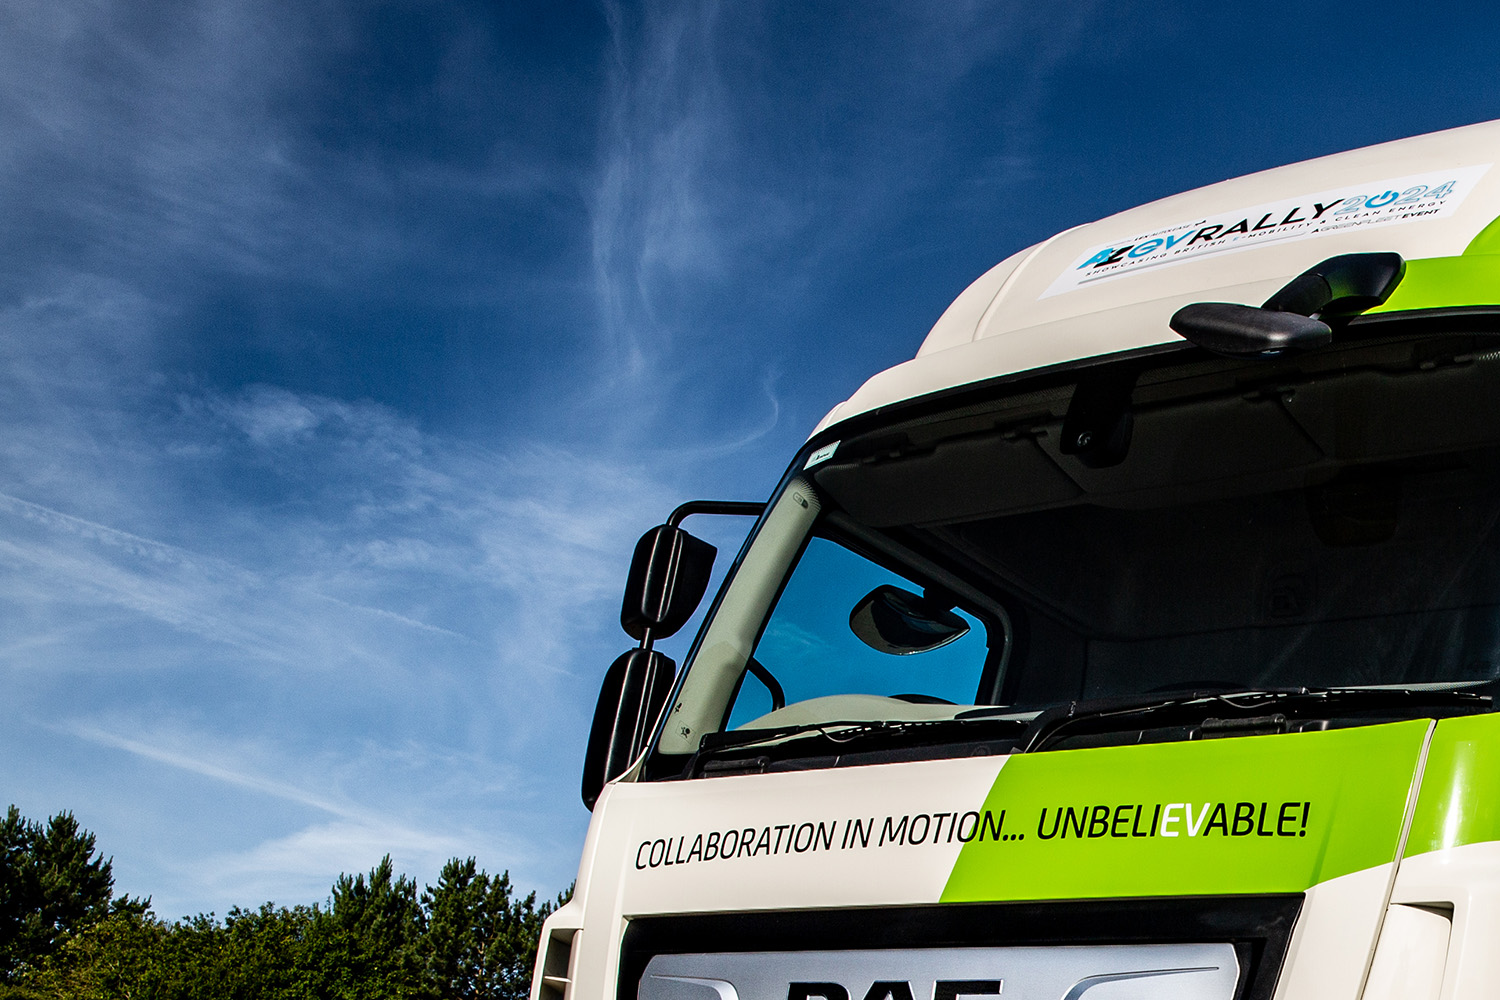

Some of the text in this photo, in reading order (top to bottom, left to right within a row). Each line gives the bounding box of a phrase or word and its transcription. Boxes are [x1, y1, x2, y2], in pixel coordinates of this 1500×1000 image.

[1085, 252, 1168, 276] SHOWCASING
[1174, 239, 1226, 255] BRITISH
[1232, 220, 1315, 241] E-MOBILITY
[1335, 210, 1382, 222] CLEAN
[1388, 200, 1448, 214] ENERGY
[634, 801, 1311, 871] COLLABORATION IN MOTION... UNBELIEVABLE!
